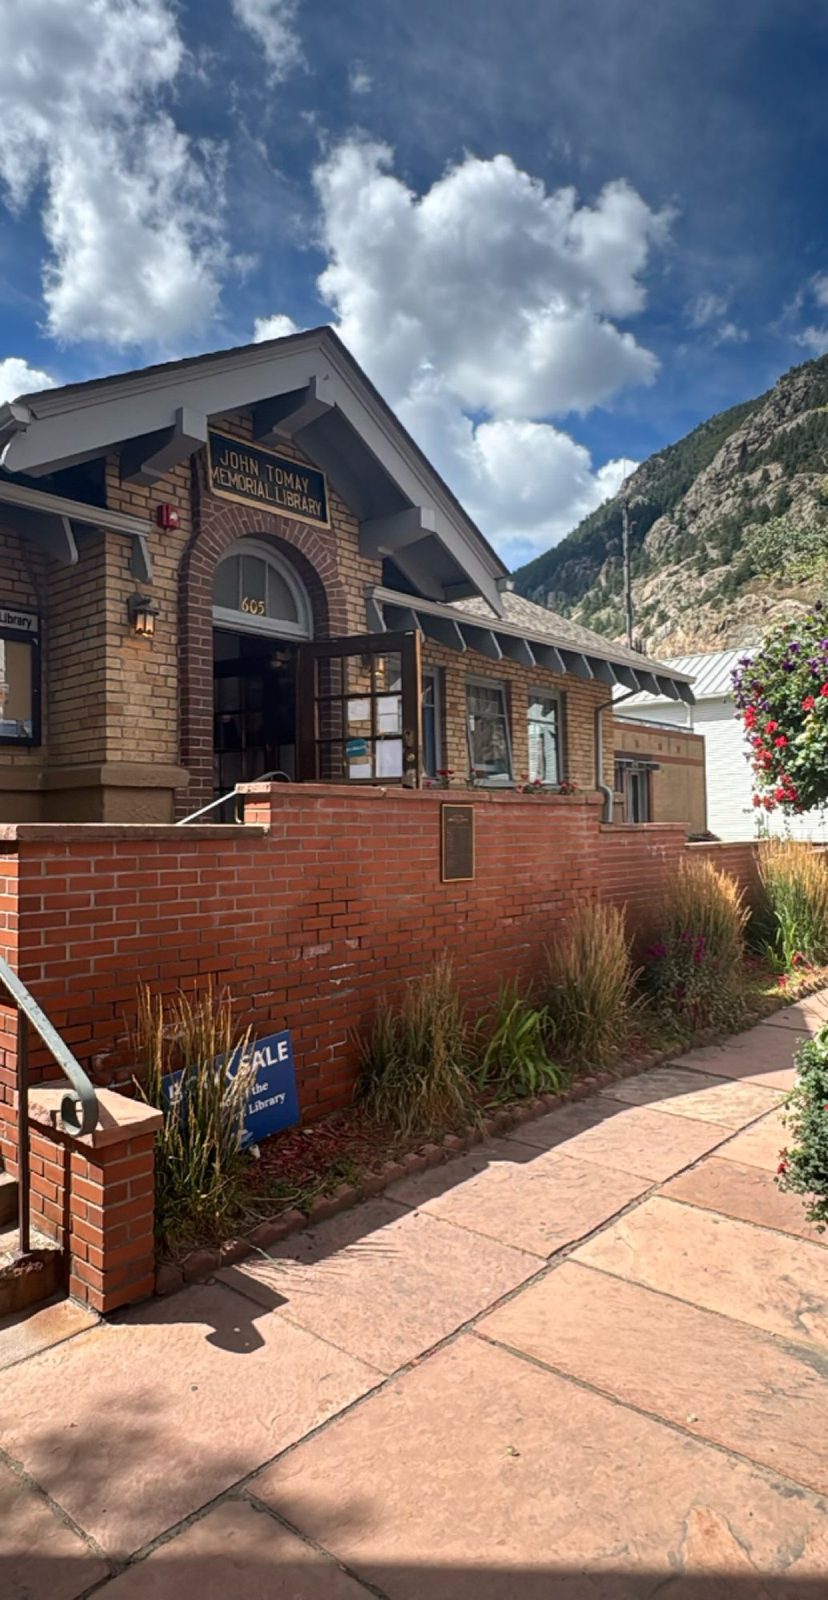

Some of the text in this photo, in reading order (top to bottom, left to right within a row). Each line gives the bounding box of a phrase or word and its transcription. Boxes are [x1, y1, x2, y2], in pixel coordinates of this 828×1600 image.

[220, 449, 309, 494] JOHN TOMAY
[211, 466, 322, 516] MEMORIAL LIBRARY
[241, 596, 265, 615] 605
[251, 1081, 269, 1096] the
[248, 1092, 287, 1115] Library
